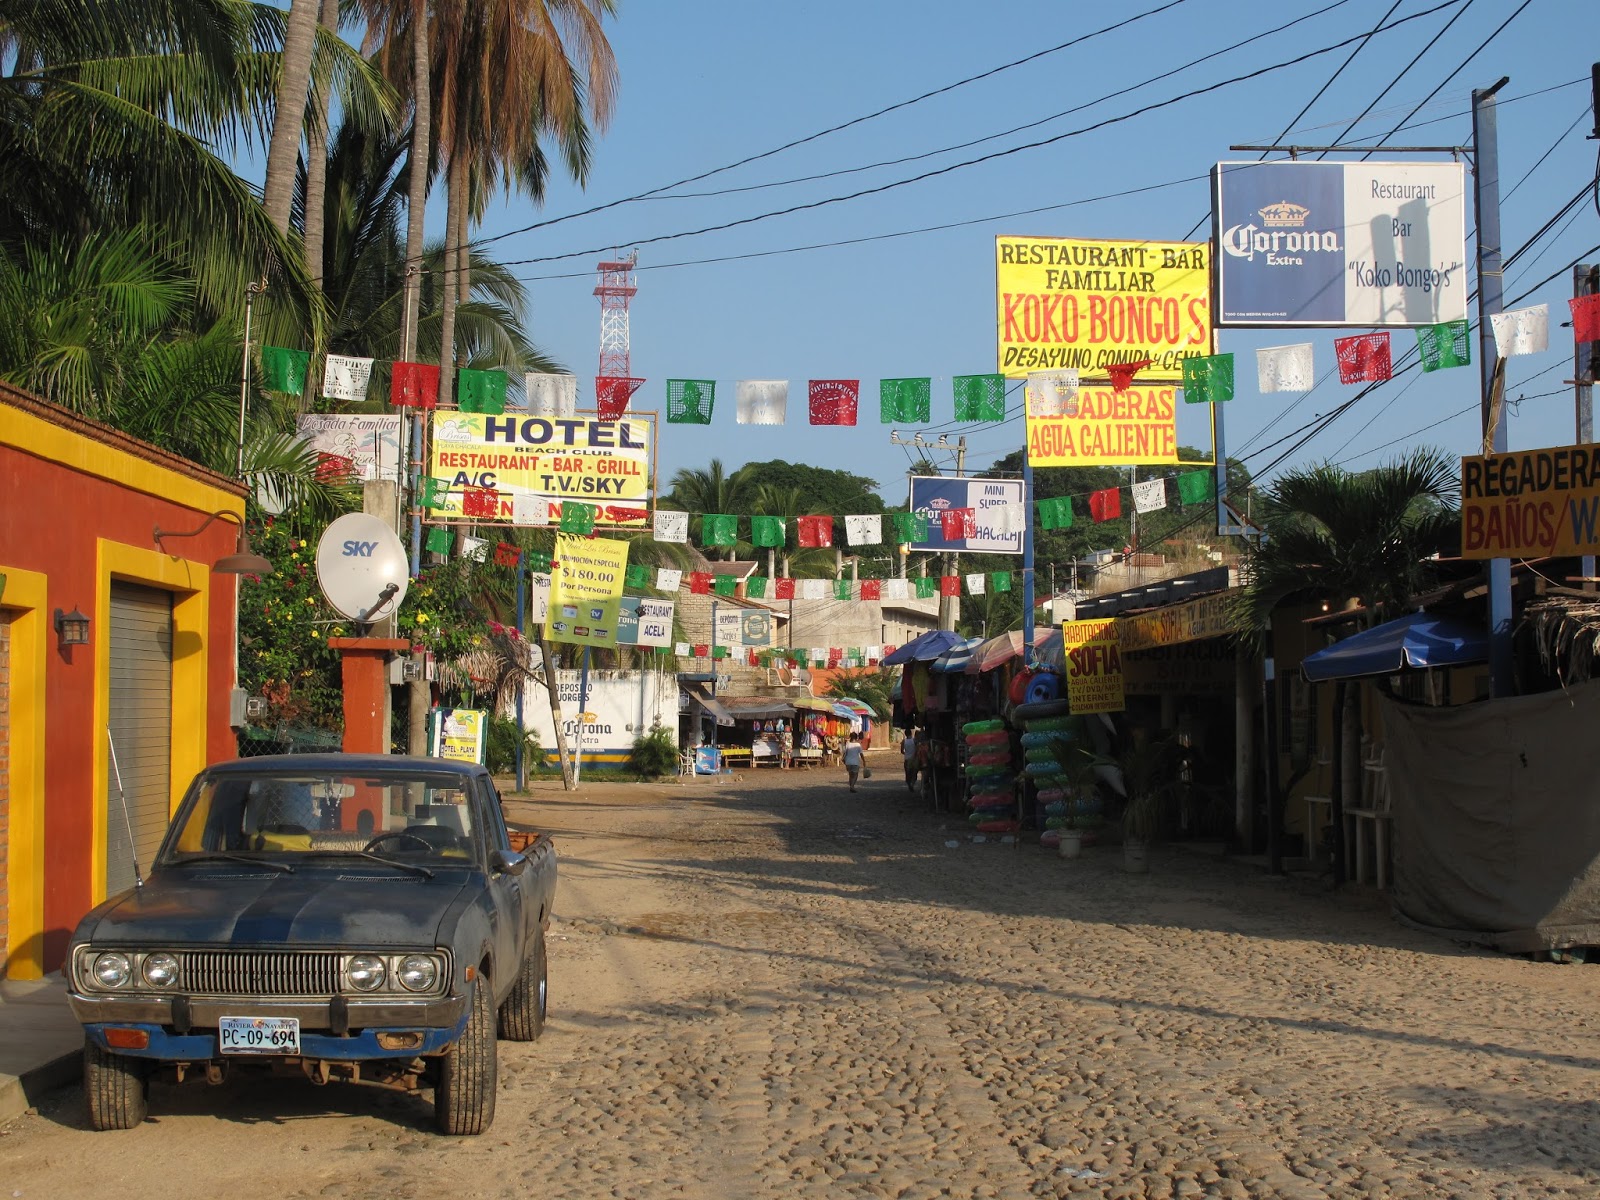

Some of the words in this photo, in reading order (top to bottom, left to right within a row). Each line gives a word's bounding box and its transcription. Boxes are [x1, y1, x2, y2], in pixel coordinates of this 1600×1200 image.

[1371, 179, 1436, 200] Restaurant
[1392, 218, 1412, 238] Bar
[1223, 223, 1339, 262] Corona
[1266, 253, 1303, 266] Extra
[1045, 269, 1156, 293] FAMILIAR
[1028, 390, 1173, 420] ADERAS
[301, 416, 346, 431] Posada
[349, 416, 400, 431] Familiar
[484, 416, 645, 449] HOTEL
[1028, 424, 1077, 458] AGUA
[1080, 424, 1175, 457] CALIENTE
[514, 446, 570, 456] BEACH
[572, 448, 613, 457] CLUB
[439, 452, 540, 471] RESTAURANT
[553, 457, 583, 473] BAR
[596, 459, 641, 476] GRILL
[451, 471, 497, 489] A/C
[540, 474, 627, 495] T.V./SKY
[984, 485, 1005, 496] MINI
[974, 526, 1017, 541] HACALA
[342, 540, 379, 557] SKY
[593, 559, 620, 569] ESPECIAL
[562, 566, 614, 583] $180.00
[618, 616, 638, 624] rona
[643, 624, 665, 637] ACELA
[1063, 622, 1120, 644] HABITACIONES
[555, 683, 593, 693] DEPOSO
[1071, 678, 1089, 686] AGUA
[1089, 675, 1121, 685] CALIENTE
[1072, 692, 1116, 703] INTERNET
[562, 719, 613, 737] Corona
[222, 1028, 296, 1046] PC-09-694
